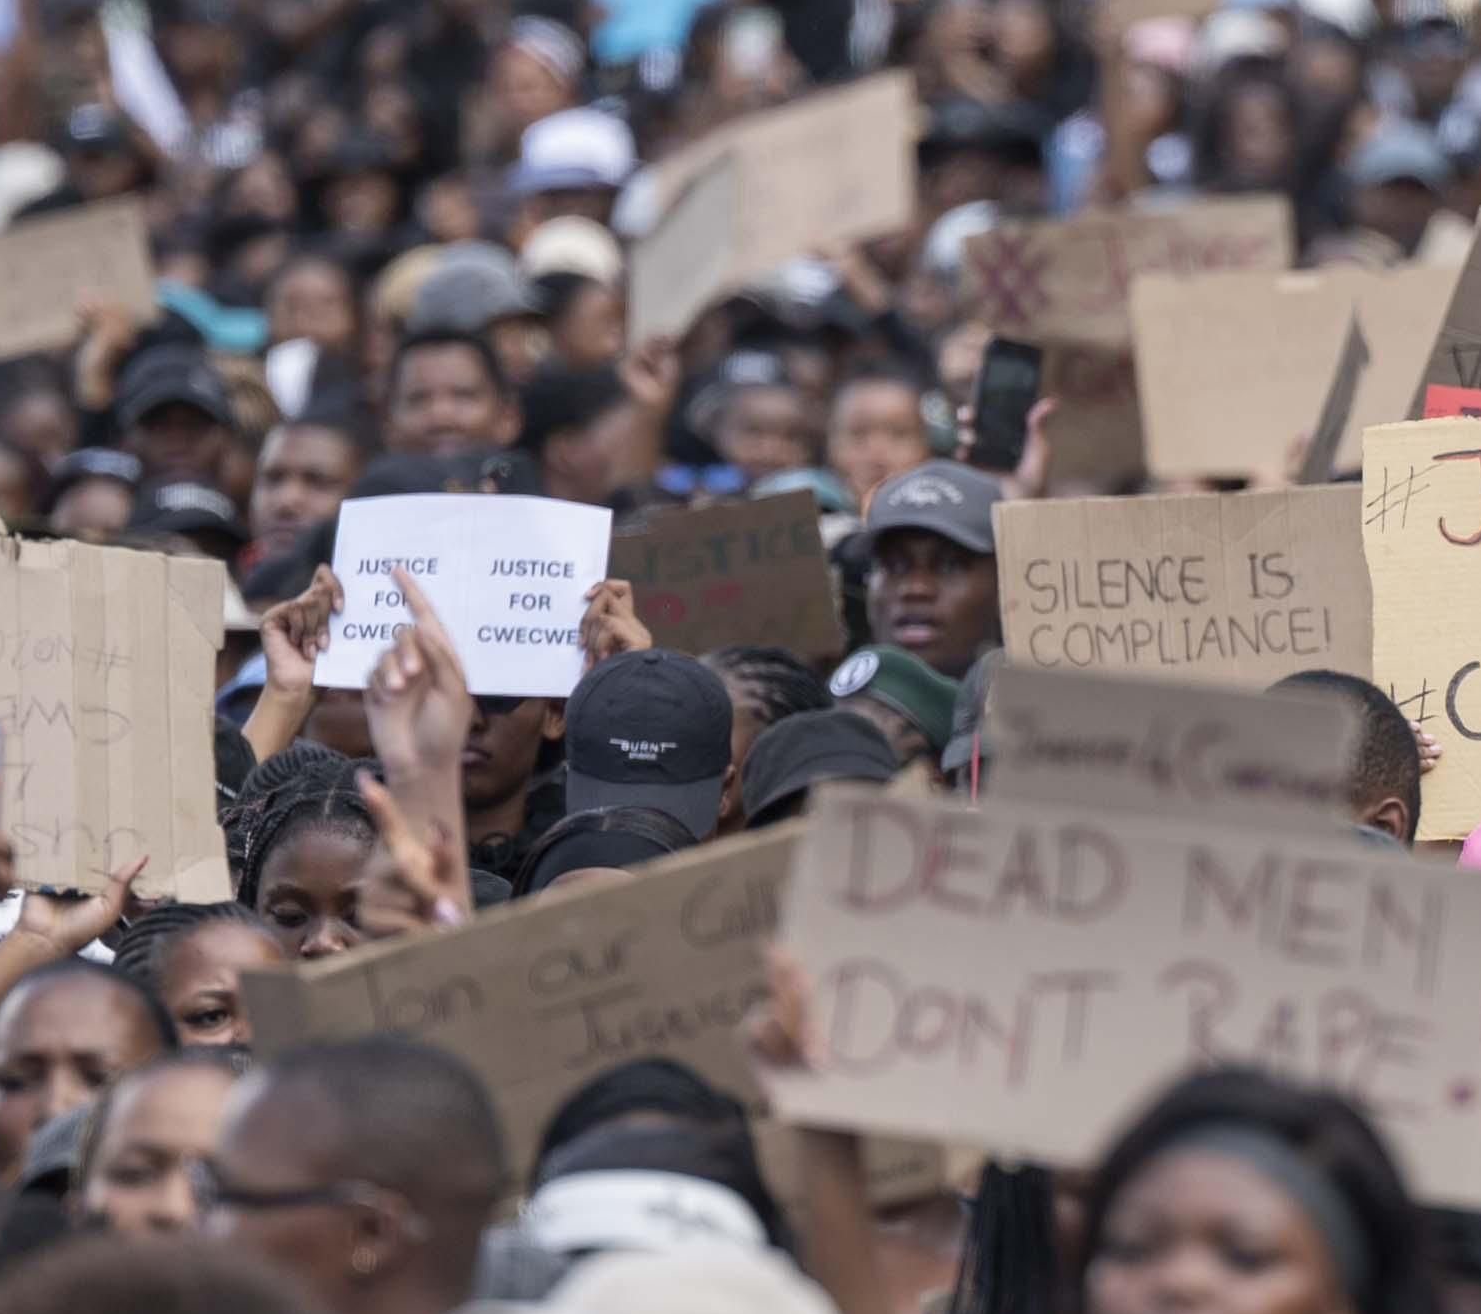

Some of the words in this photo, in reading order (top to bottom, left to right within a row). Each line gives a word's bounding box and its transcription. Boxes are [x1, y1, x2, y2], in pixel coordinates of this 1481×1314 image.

[356, 557, 439, 576] JUSTICE
[489, 558, 575, 579] JUSTICE
[1024, 555, 1208, 615] SILENCE
[1246, 551, 1296, 601] IS
[508, 593, 552, 611] FOR
[476, 625, 581, 647] CWECWE
[1029, 605, 1333, 669] COMPLIANCE!
[837, 796, 1139, 926] DEAD
[1180, 846, 1444, 999] MEN
